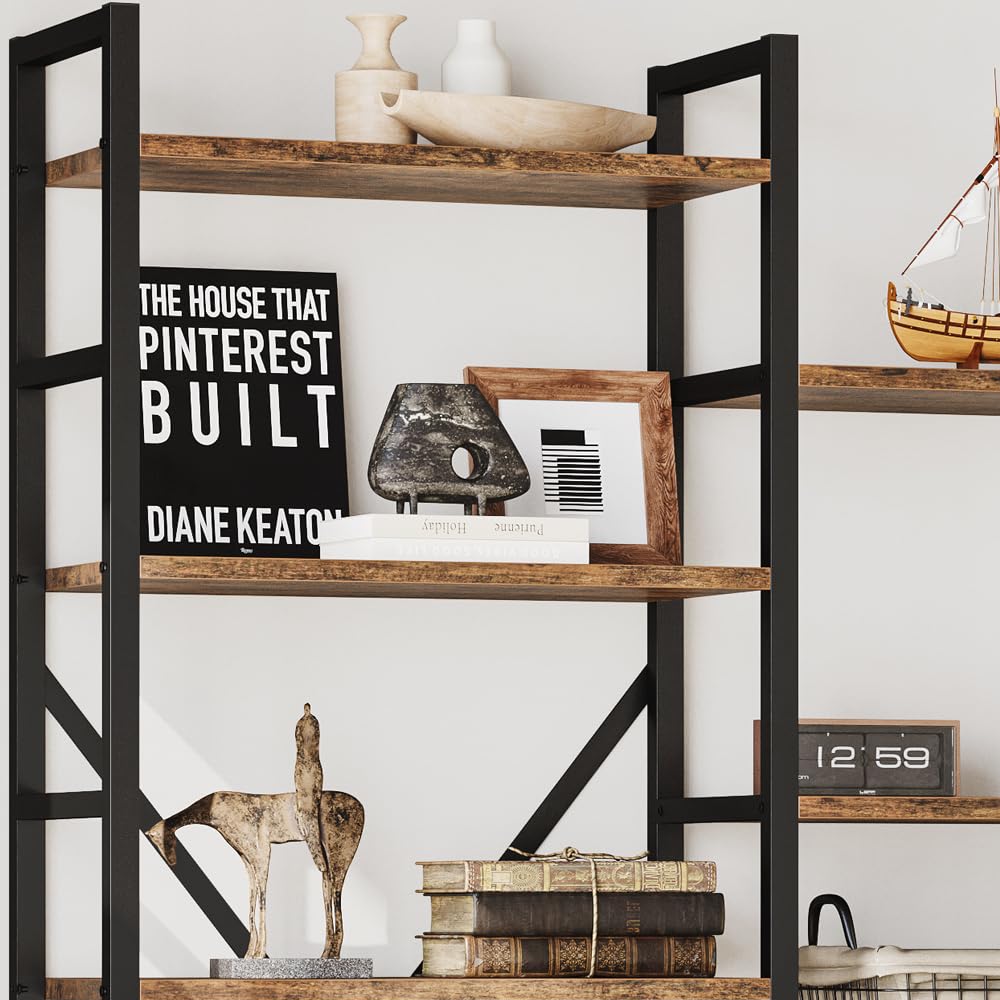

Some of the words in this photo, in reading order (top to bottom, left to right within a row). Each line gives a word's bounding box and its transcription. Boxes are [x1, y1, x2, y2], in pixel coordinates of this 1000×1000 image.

[139, 283, 182, 317] THE
[188, 284, 267, 320] HOUSE
[271, 287, 330, 322] THAT
[139, 325, 333, 376] PINTEREST
[141, 380, 336, 449] BUILT
[147, 505, 231, 544] DIANE
[422, 518, 466, 535] Holiday
[494, 521, 544, 536] Purienne
